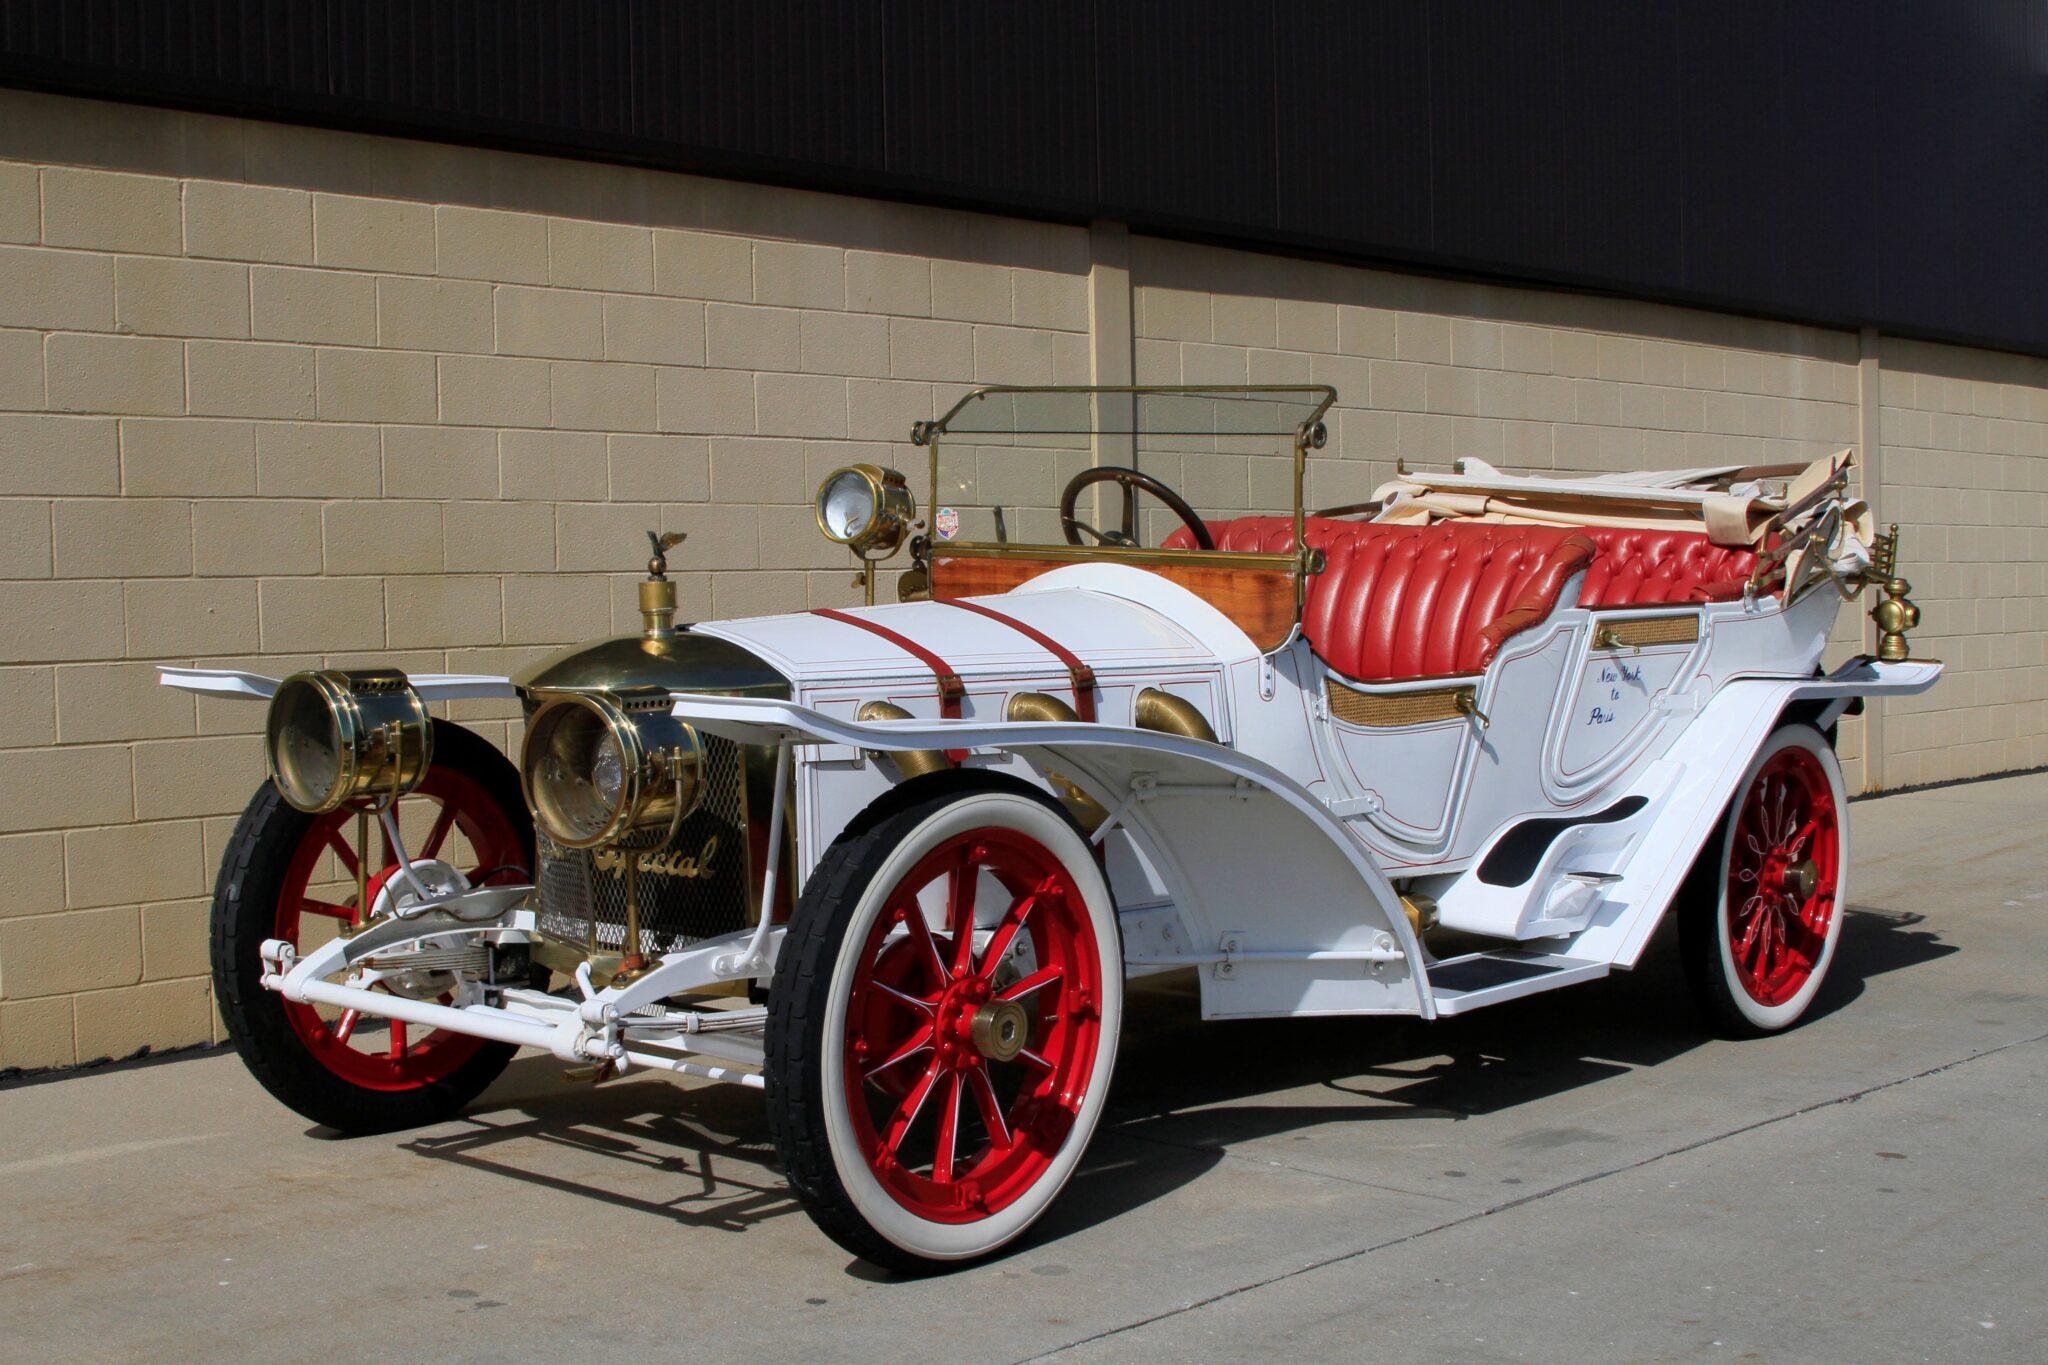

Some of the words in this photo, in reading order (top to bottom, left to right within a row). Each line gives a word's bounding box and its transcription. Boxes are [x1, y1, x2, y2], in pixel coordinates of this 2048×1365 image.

[1596, 666, 1618, 683] New
[1620, 664, 1641, 681] York
[1610, 687, 1620, 701] to
[1586, 707, 1614, 725] Paris
